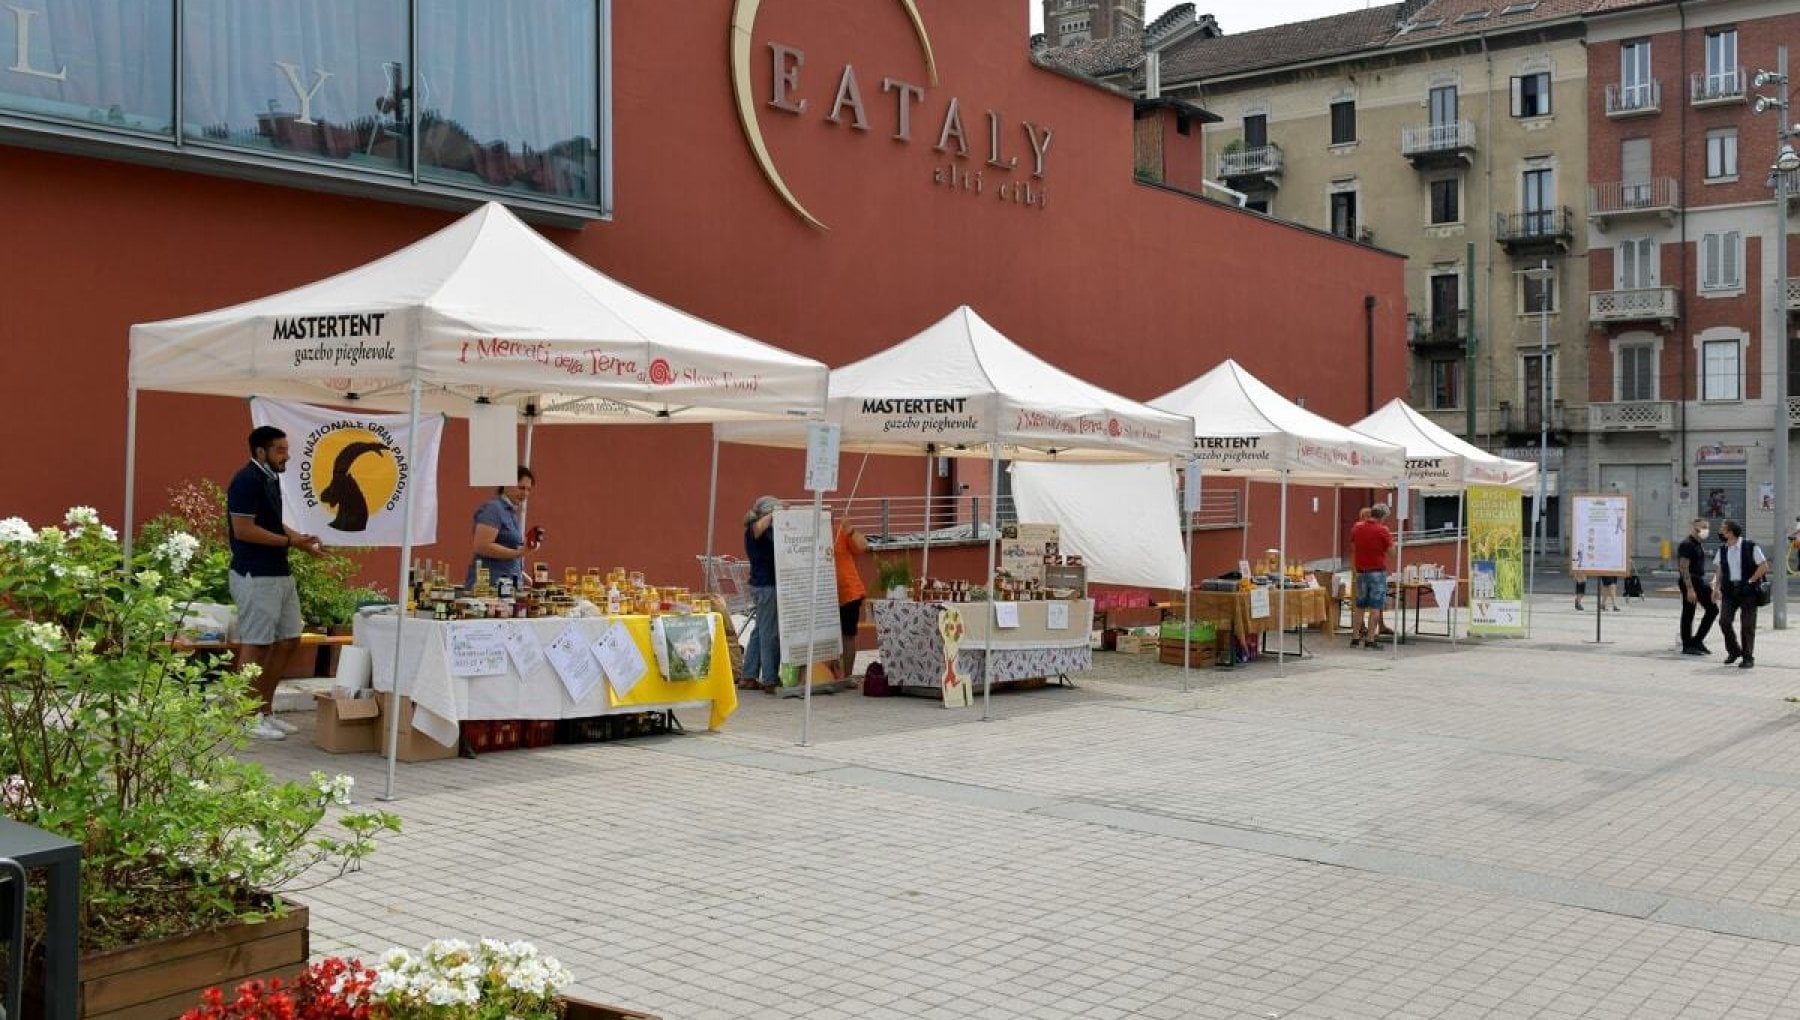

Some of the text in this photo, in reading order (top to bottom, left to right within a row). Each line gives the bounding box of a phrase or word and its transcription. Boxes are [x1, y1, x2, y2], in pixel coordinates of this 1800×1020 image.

[768, 41, 1053, 178] EATALY
[934, 163, 1049, 209] alti cibi
[272, 312, 385, 341] MASTERTENT
[293, 340, 396, 367] gazebo pieghevole
[456, 342, 469, 363] I
[476, 337, 551, 364] Mercati
[554, 355, 584, 375] della
[583, 348, 637, 376] Terra
[683, 367, 717, 387] Slow
[861, 397, 967, 414] MASTERTENT
[882, 415, 978, 433] gazebo pieghevole
[300, 420, 409, 511] PARCO NAZIONALE GRAN PARADISO
[1222, 450, 1270, 463] pieghevole
